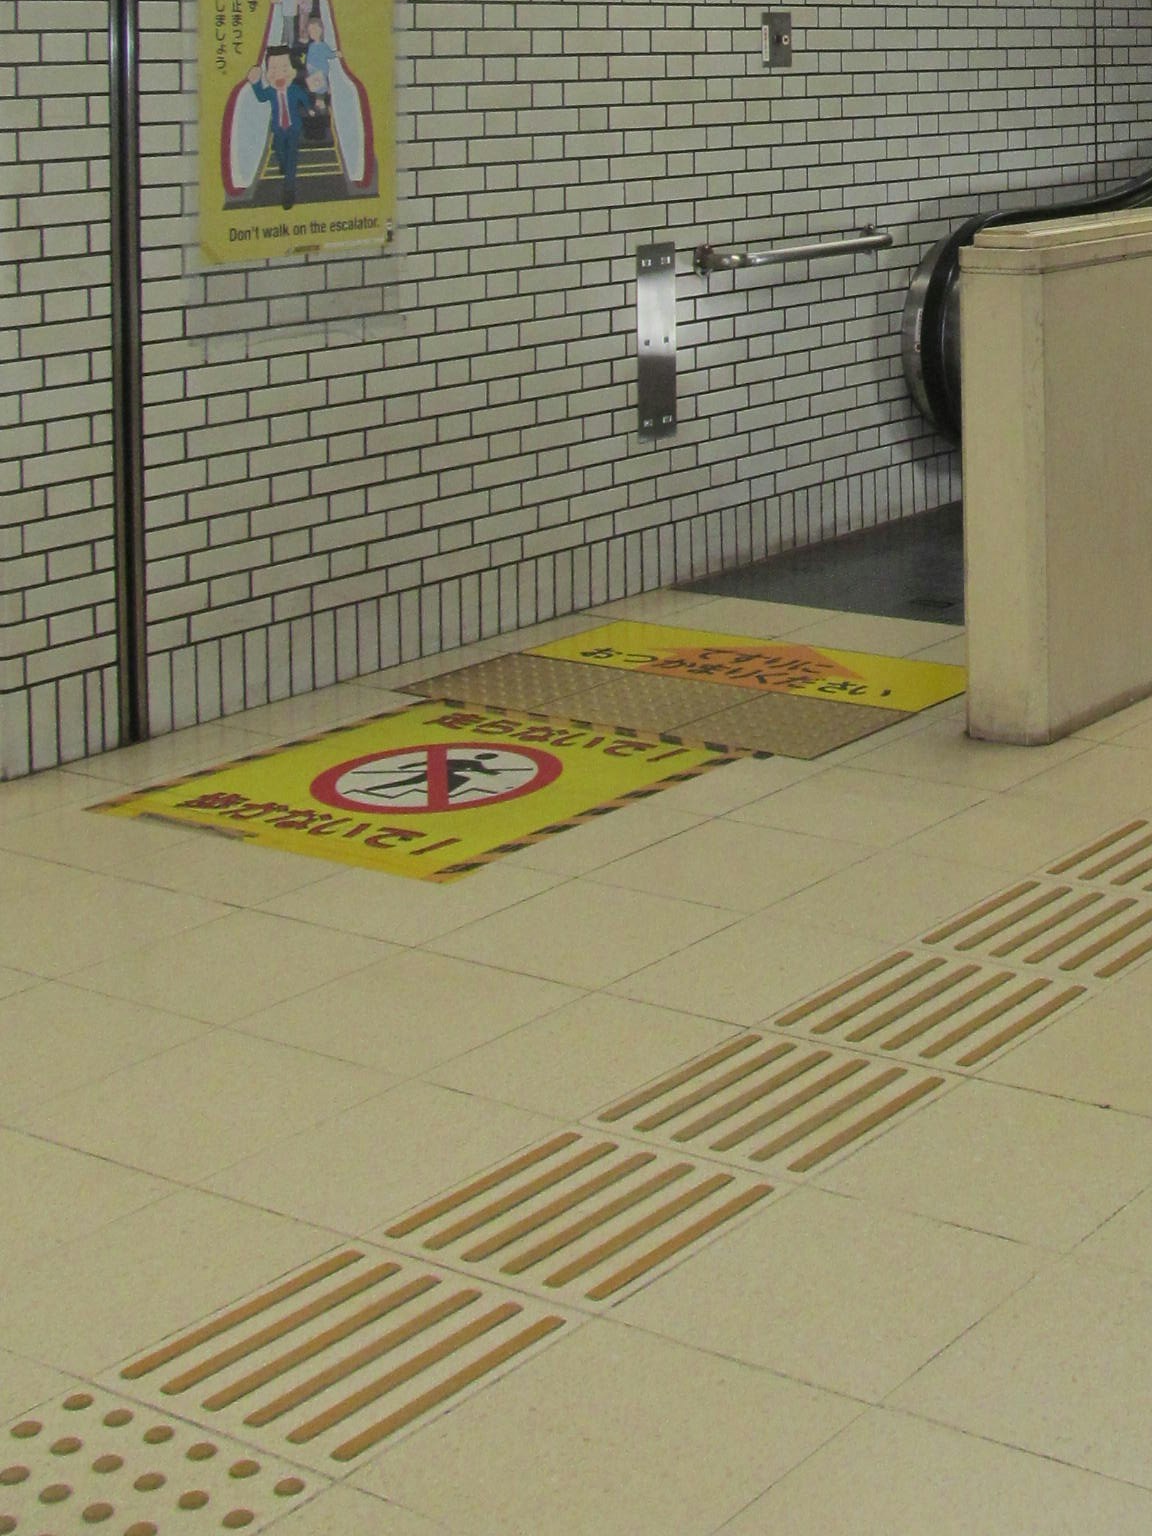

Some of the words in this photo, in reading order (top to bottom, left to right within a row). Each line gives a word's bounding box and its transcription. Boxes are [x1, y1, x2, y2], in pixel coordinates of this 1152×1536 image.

[229, 226, 260, 242] Don't
[262, 224, 289, 238] walk
[293, 224, 307, 236] on
[310, 220, 326, 234] the
[329, 216, 380, 233] escalator.
[579, 646, 892, 698] おつかまりください
[699, 647, 834, 674] てすりに
[422, 711, 691, 765] 走らないで！
